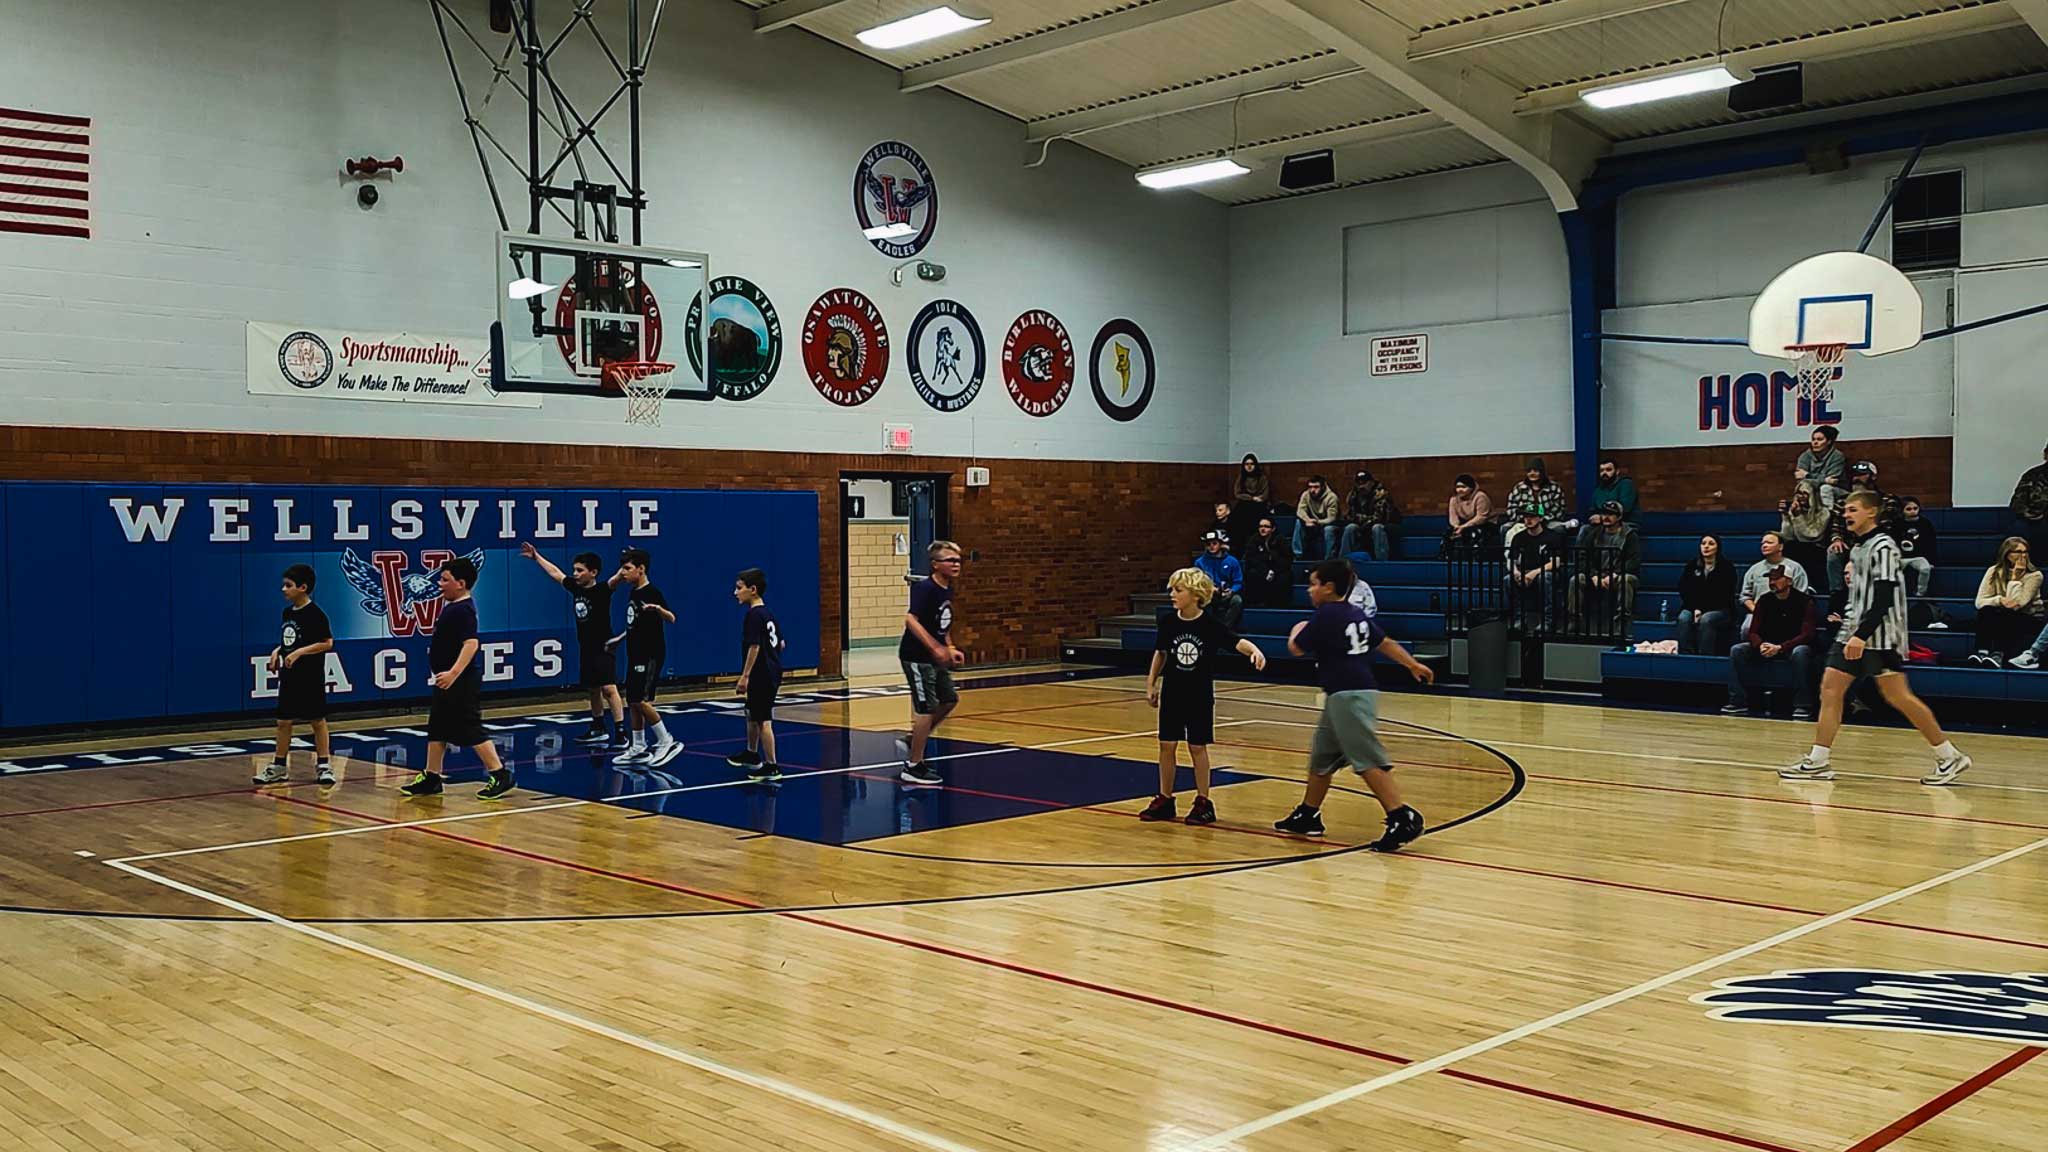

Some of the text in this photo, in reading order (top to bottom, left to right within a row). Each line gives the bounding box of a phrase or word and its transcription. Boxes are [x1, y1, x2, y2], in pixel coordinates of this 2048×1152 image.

[864, 144, 928, 177] WELLSVILLE
[877, 239, 916, 257] EAGLES
[755, 290, 780, 338] VIEW
[804, 292, 887, 348] OSAWATOMIE
[935, 303, 958, 315] IOLA
[340, 336, 469, 372] Sportsmanship...
[1004, 313, 1073, 368] BURLINGTON
[1377, 347, 1420, 357] OCCUPANCY
[1380, 338, 1418, 348] MAXIMUM
[1390, 362, 1423, 371] PERSONS
[337, 373, 470, 395] You Make The Difference!
[716, 374, 767, 396] FFALO
[814, 372, 879, 403] TROJANS
[947, 378, 982, 410] MUSTANGS
[1008, 378, 1070, 413] WILDCATS
[1699, 367, 1843, 430] HOME
[109, 498, 659, 542] WELLSVILLE
[766, 620, 778, 648] 3
[1345, 621, 1369, 654] 12
[251, 639, 562, 698] EAGES
